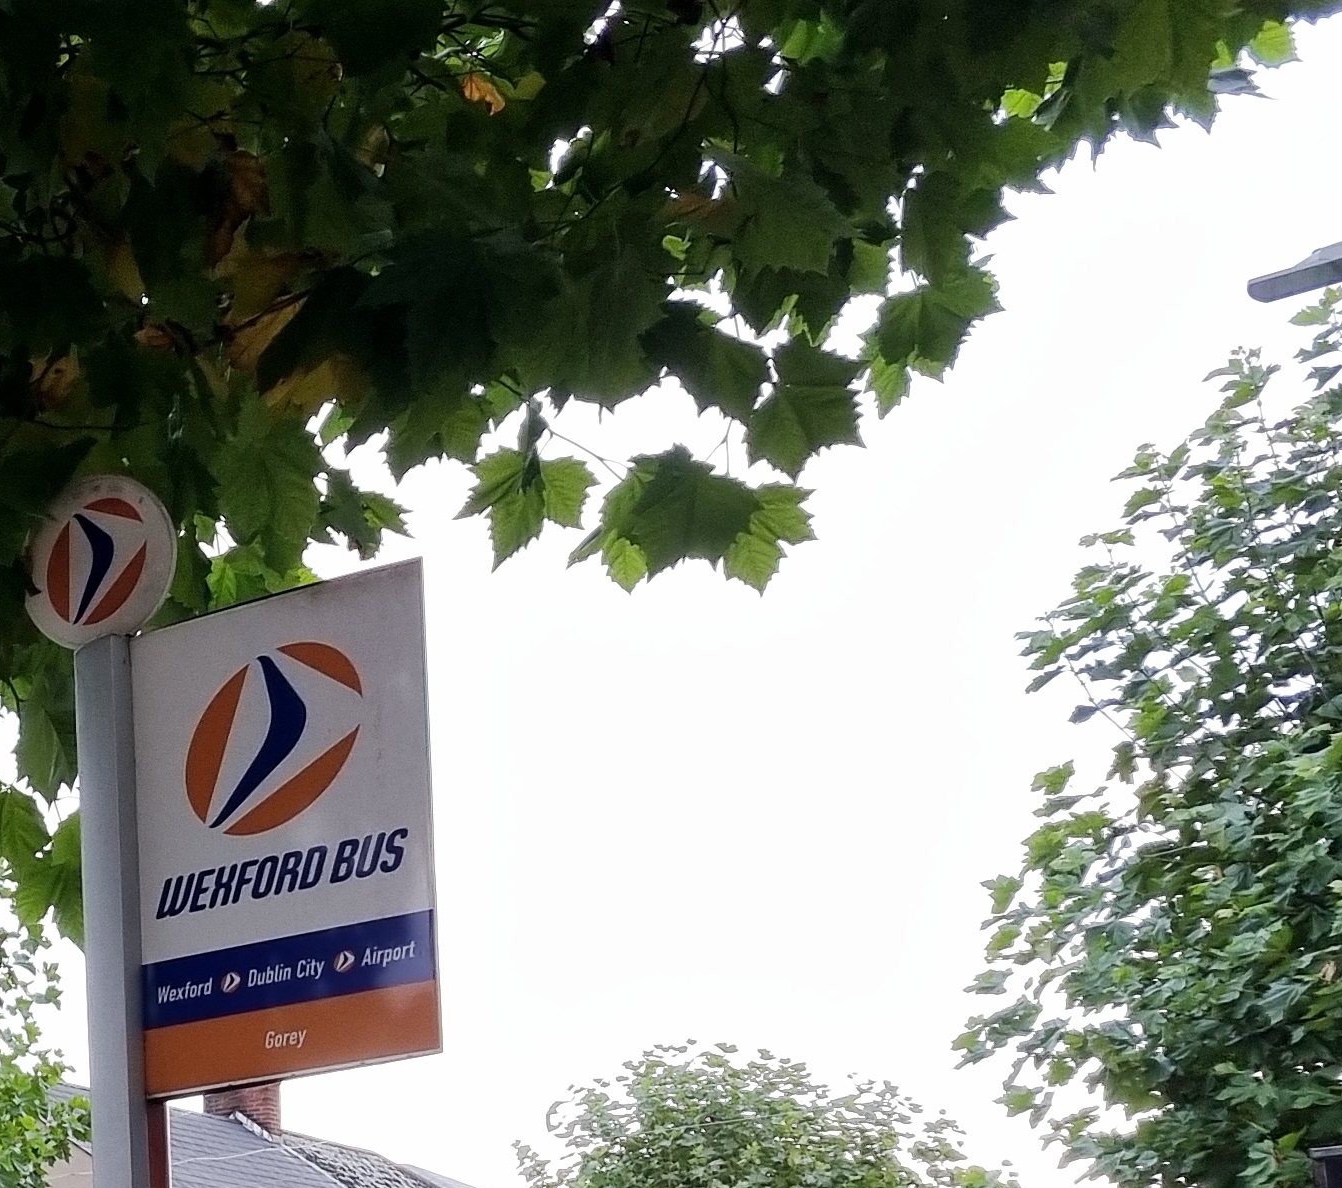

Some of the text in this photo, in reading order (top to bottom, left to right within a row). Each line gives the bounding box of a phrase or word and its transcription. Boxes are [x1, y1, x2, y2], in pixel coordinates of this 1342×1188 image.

[155, 827, 409, 920] WEXFORD BUS
[157, 940, 416, 1004] Wexford Dublin City Airport
[265, 1029, 307, 1049] Gorey
